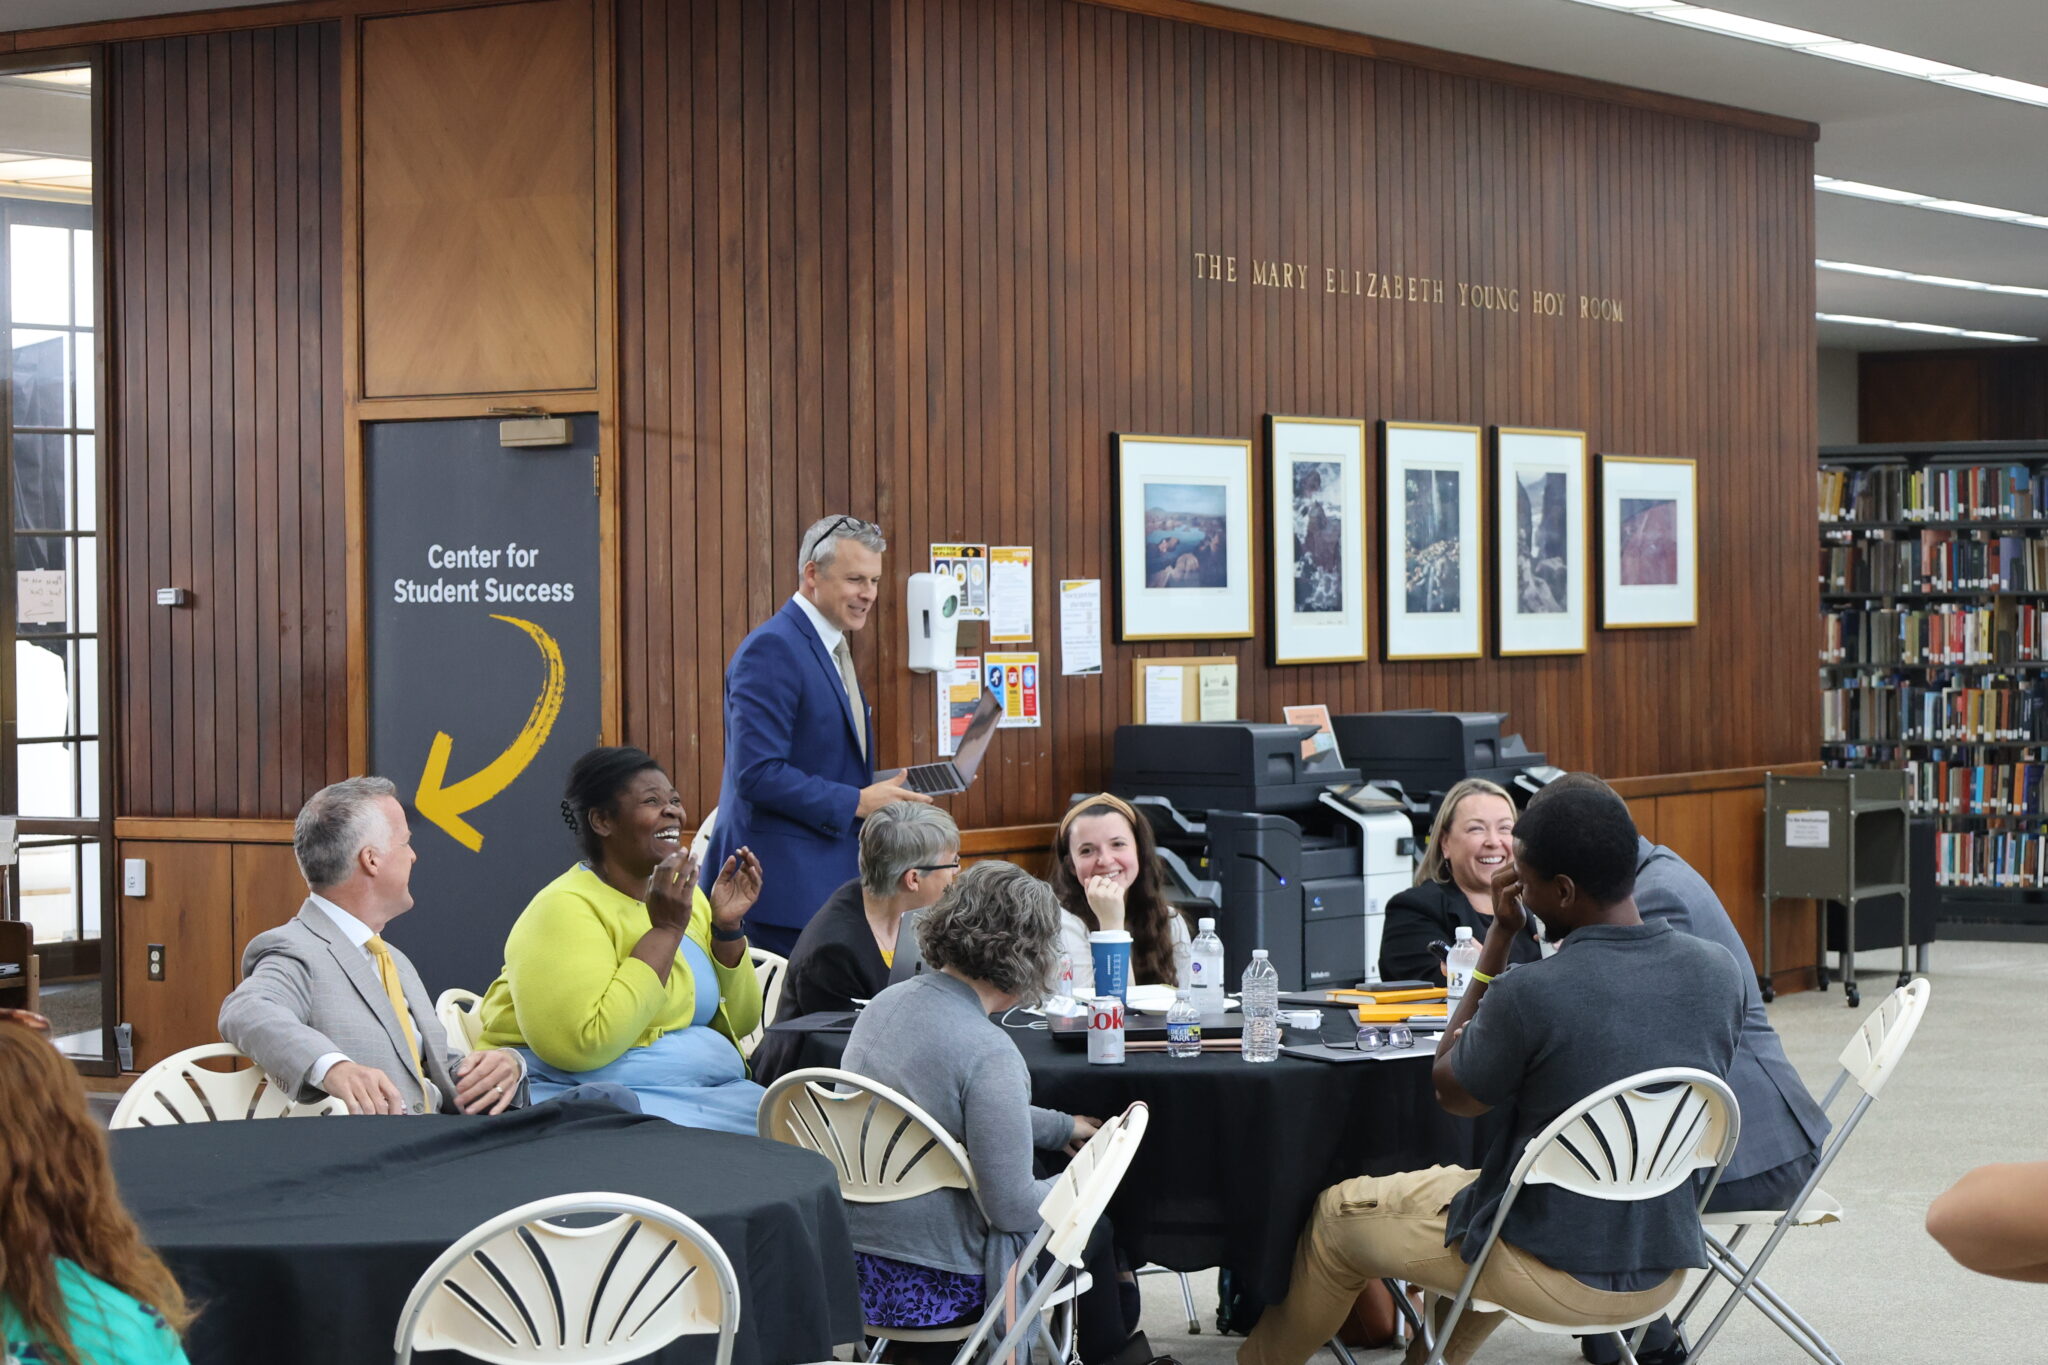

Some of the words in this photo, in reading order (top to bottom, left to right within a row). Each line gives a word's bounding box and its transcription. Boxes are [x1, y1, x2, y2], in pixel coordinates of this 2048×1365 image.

[1194, 253, 1237, 282] THE
[1252, 260, 1308, 290] MARY
[1326, 268, 1444, 304] ELIZABETH
[1458, 282, 1519, 313] YOUNG
[1532, 290, 1566, 317] HOY
[1580, 295, 1624, 322] ROOM
[428, 544, 502, 569] Center
[506, 543, 539, 568] for
[394, 578, 479, 603] Student
[484, 577, 575, 602] Success
[1171, 1034, 1190, 1042] PARK
